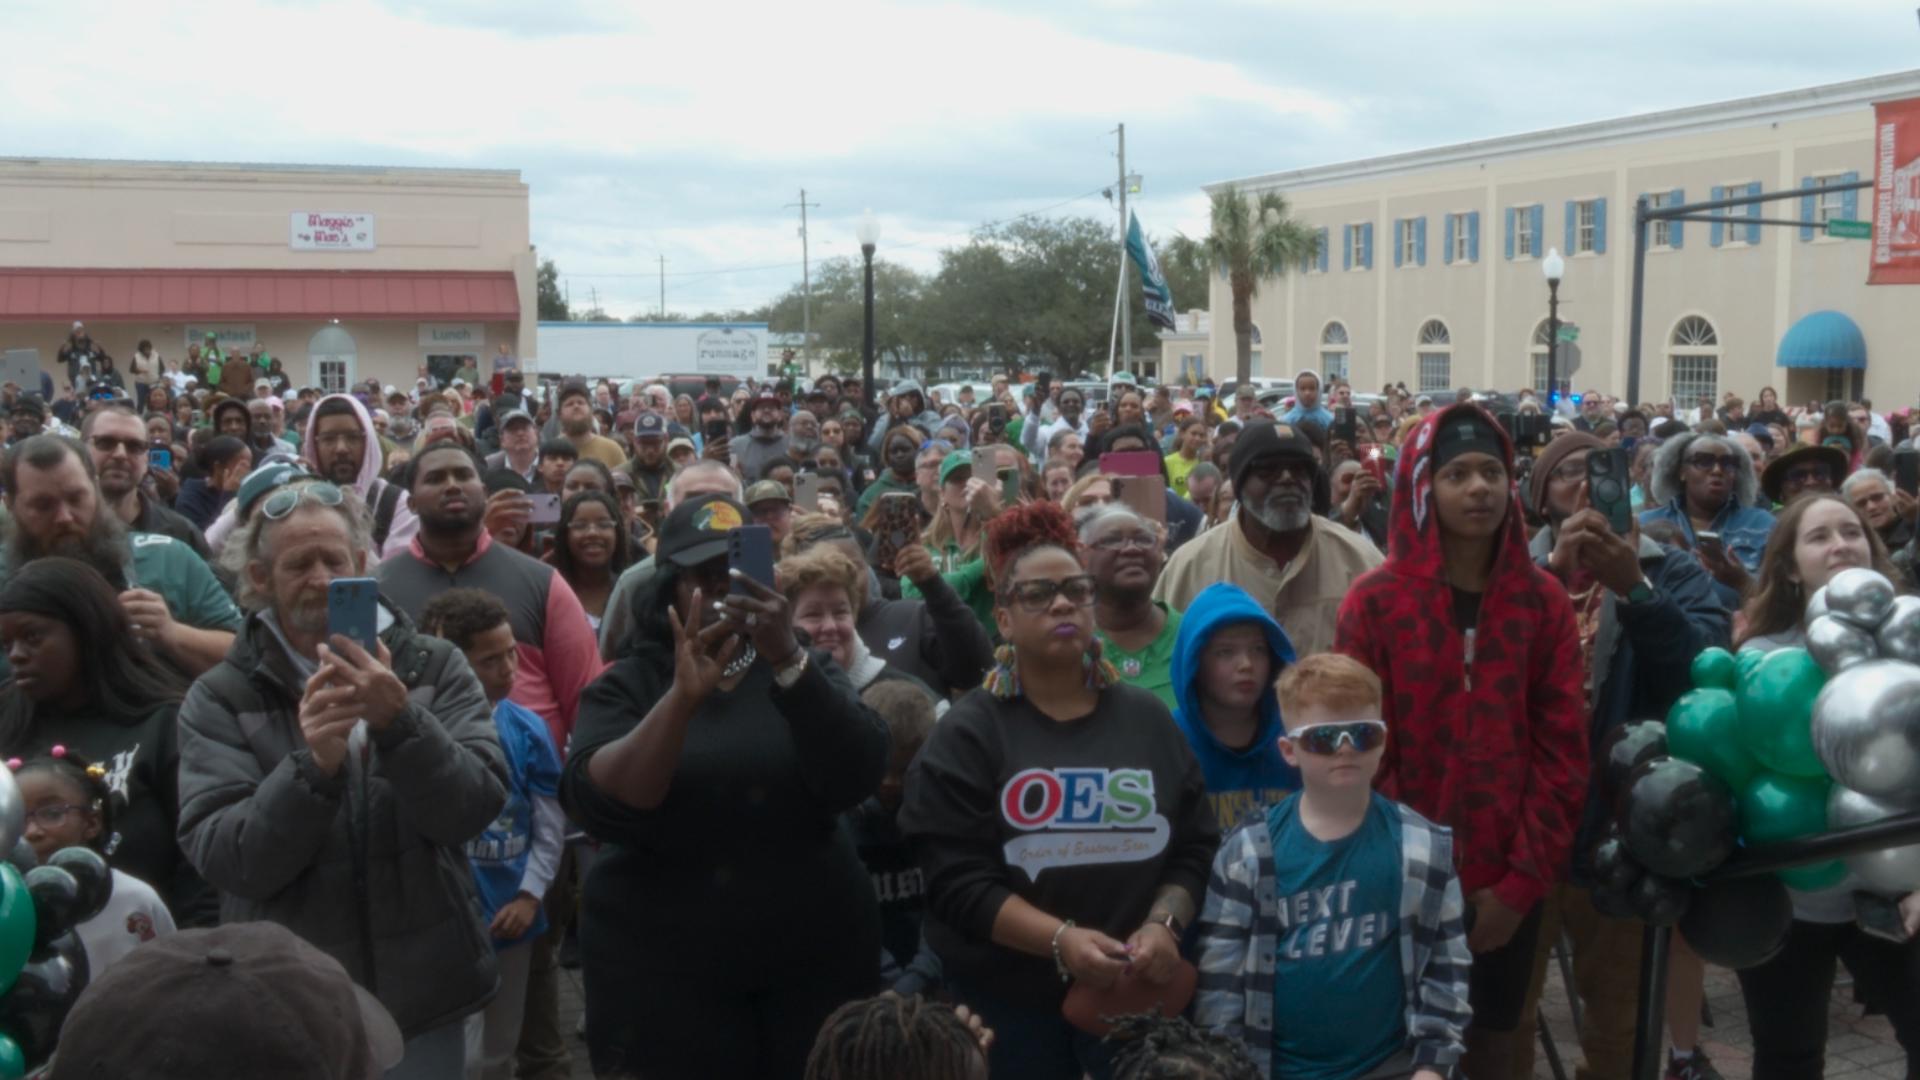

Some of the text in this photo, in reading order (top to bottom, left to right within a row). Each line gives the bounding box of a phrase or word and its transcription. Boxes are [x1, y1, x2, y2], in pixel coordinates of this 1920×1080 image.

[1878, 123, 1895, 189] DOWNTOWN
[432, 327, 471, 341] Lunch
[1003, 769, 1155, 829] OES
[1057, 842, 1071, 860] of
